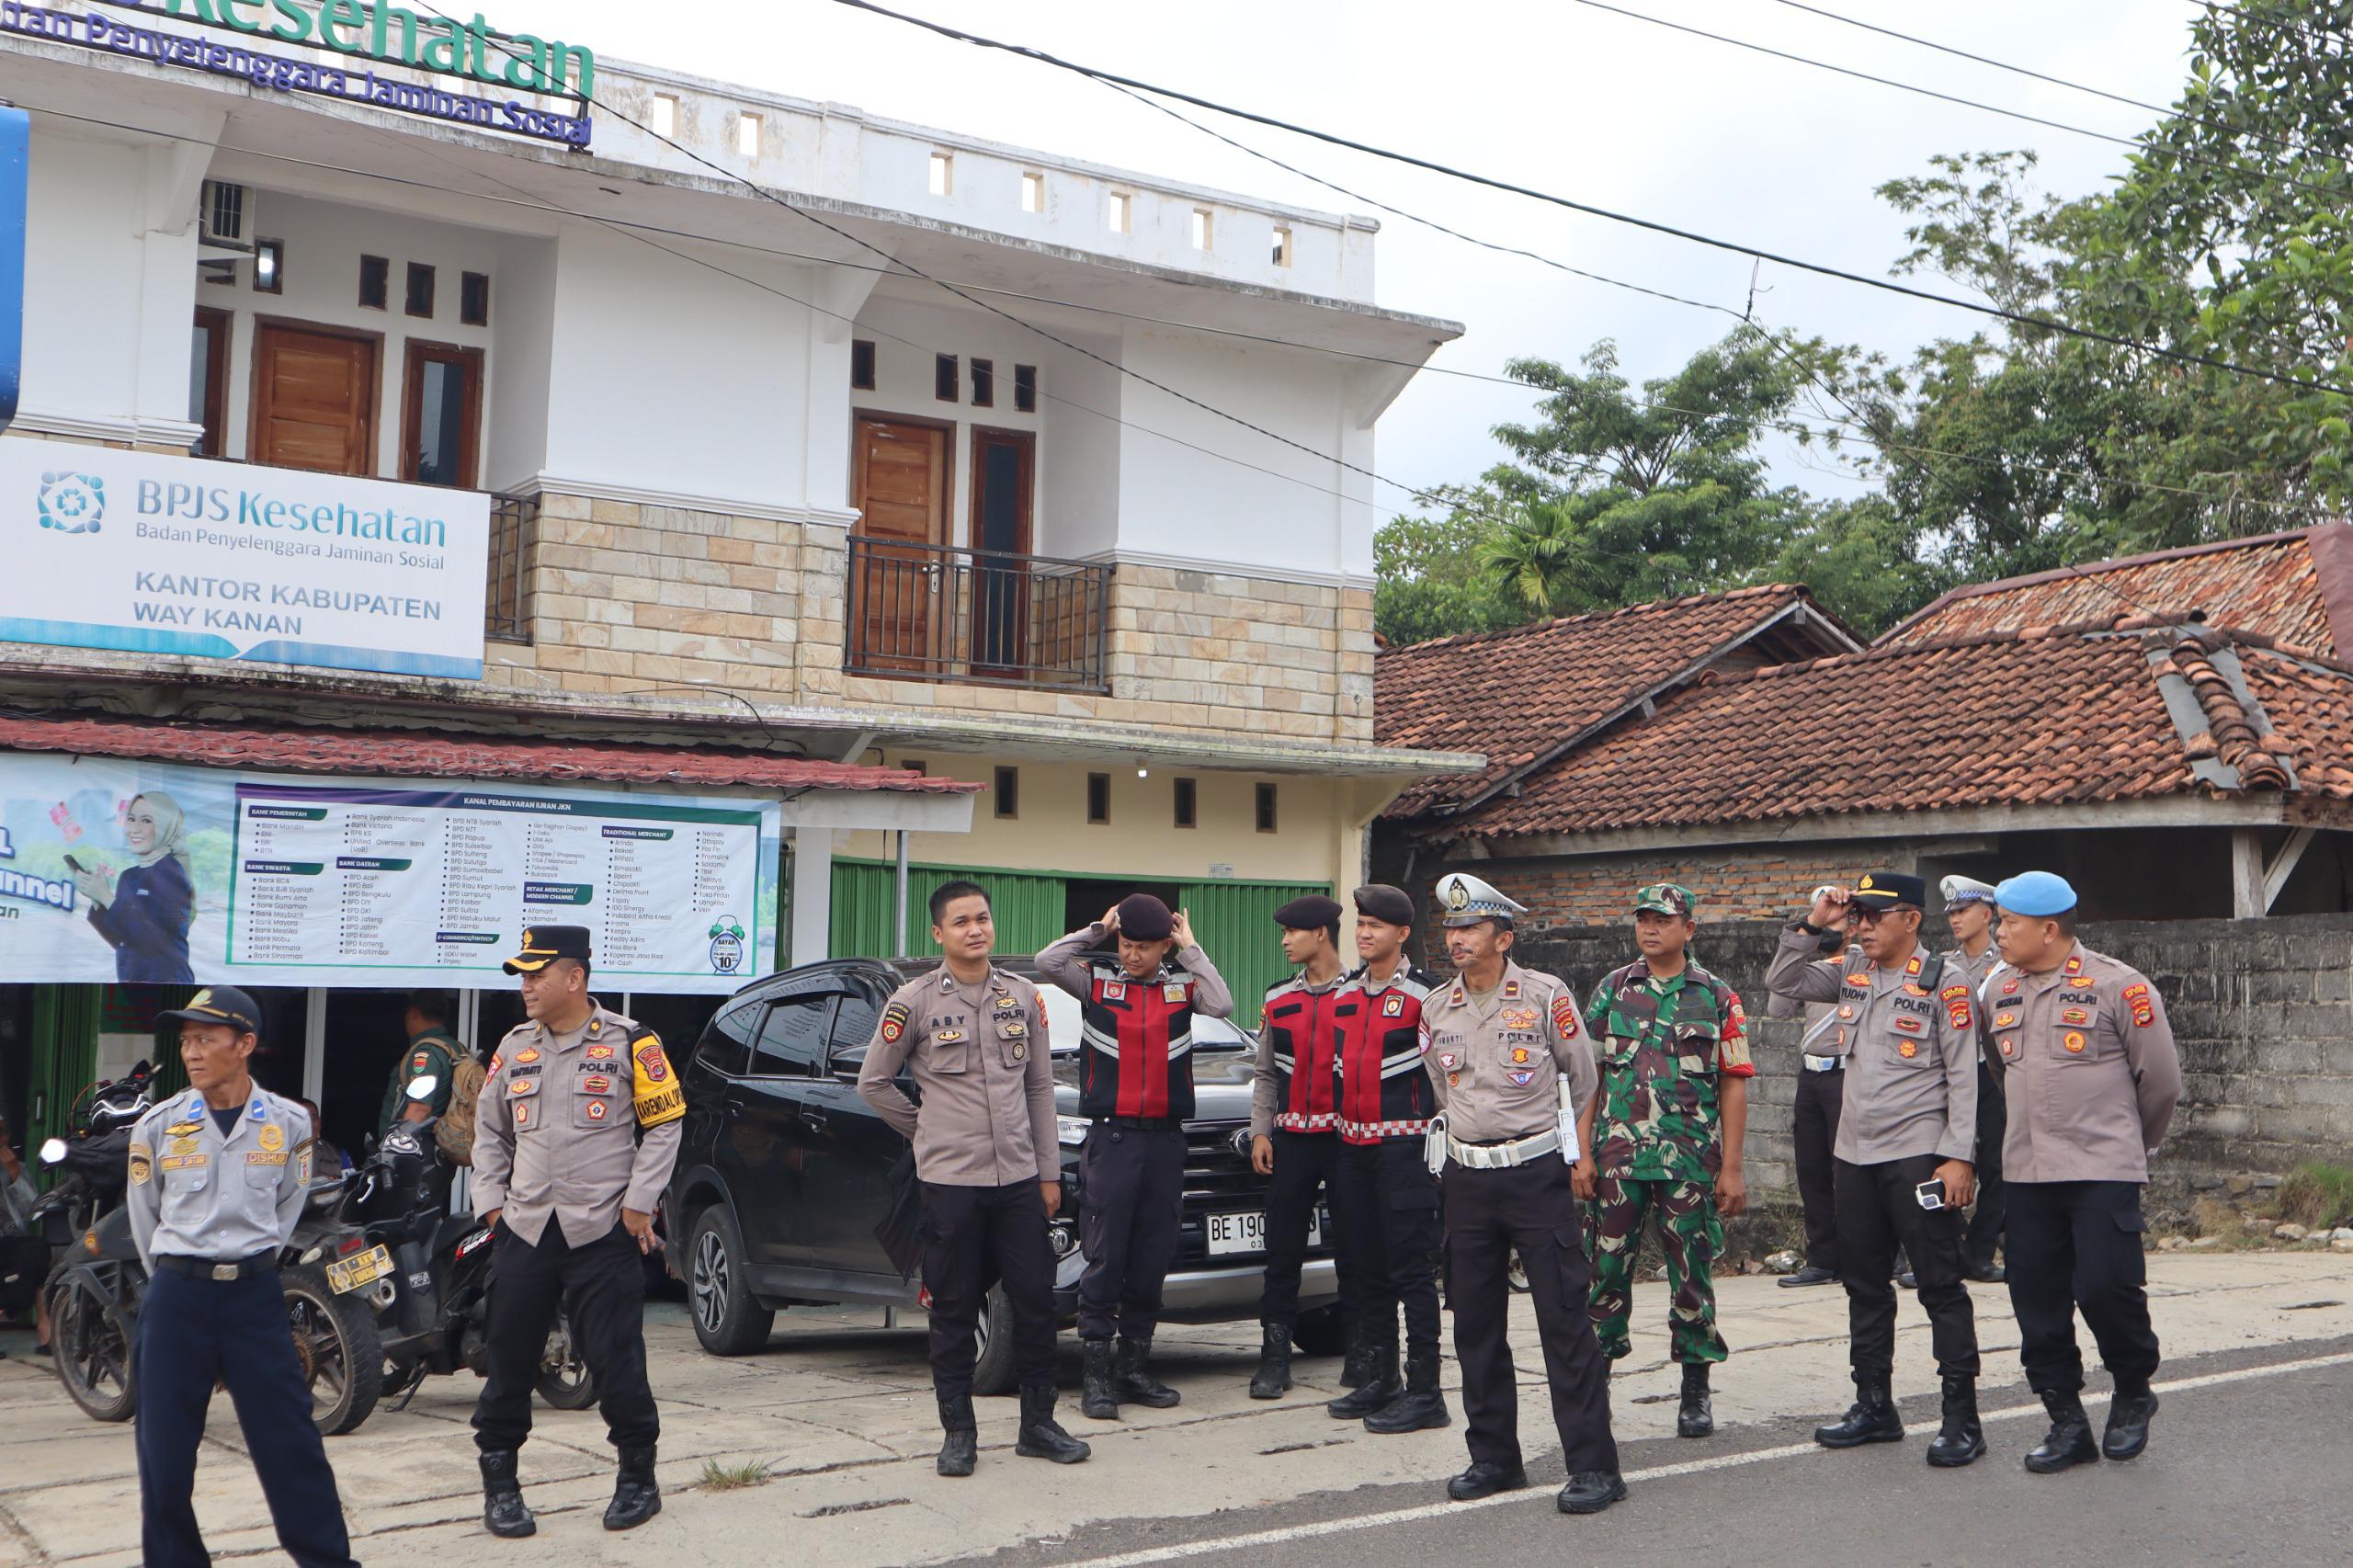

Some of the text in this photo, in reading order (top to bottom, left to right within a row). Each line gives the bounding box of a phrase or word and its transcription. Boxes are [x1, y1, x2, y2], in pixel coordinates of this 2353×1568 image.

[86, 11, 347, 97] Penyelenggara
[358, 71, 494, 126] Jaminan
[503, 101, 593, 146] Sosial
[137, 479, 447, 548] BPJS Kesehatan
[136, 521, 445, 570] Badan Penyelenggara Jaminan Sosial
[135, 571, 441, 621] KANTOR KABUPATEN
[132, 601, 302, 636] WAY KANAN
[488, 799, 535, 809] PEMBAYARAN
[361, 891, 391, 899] Bengkulu
[461, 891, 491, 899] Lampung
[719, 957, 732, 968] 10
[1893, 997, 1930, 1015] POLRI
[2059, 994, 2097, 1006] POLRI
[993, 1009, 1025, 1022] POLRI
[578, 1062, 618, 1074] POLRI
[249, 1153, 286, 1164] DISHUB
[1212, 1217, 1231, 1241] BE
